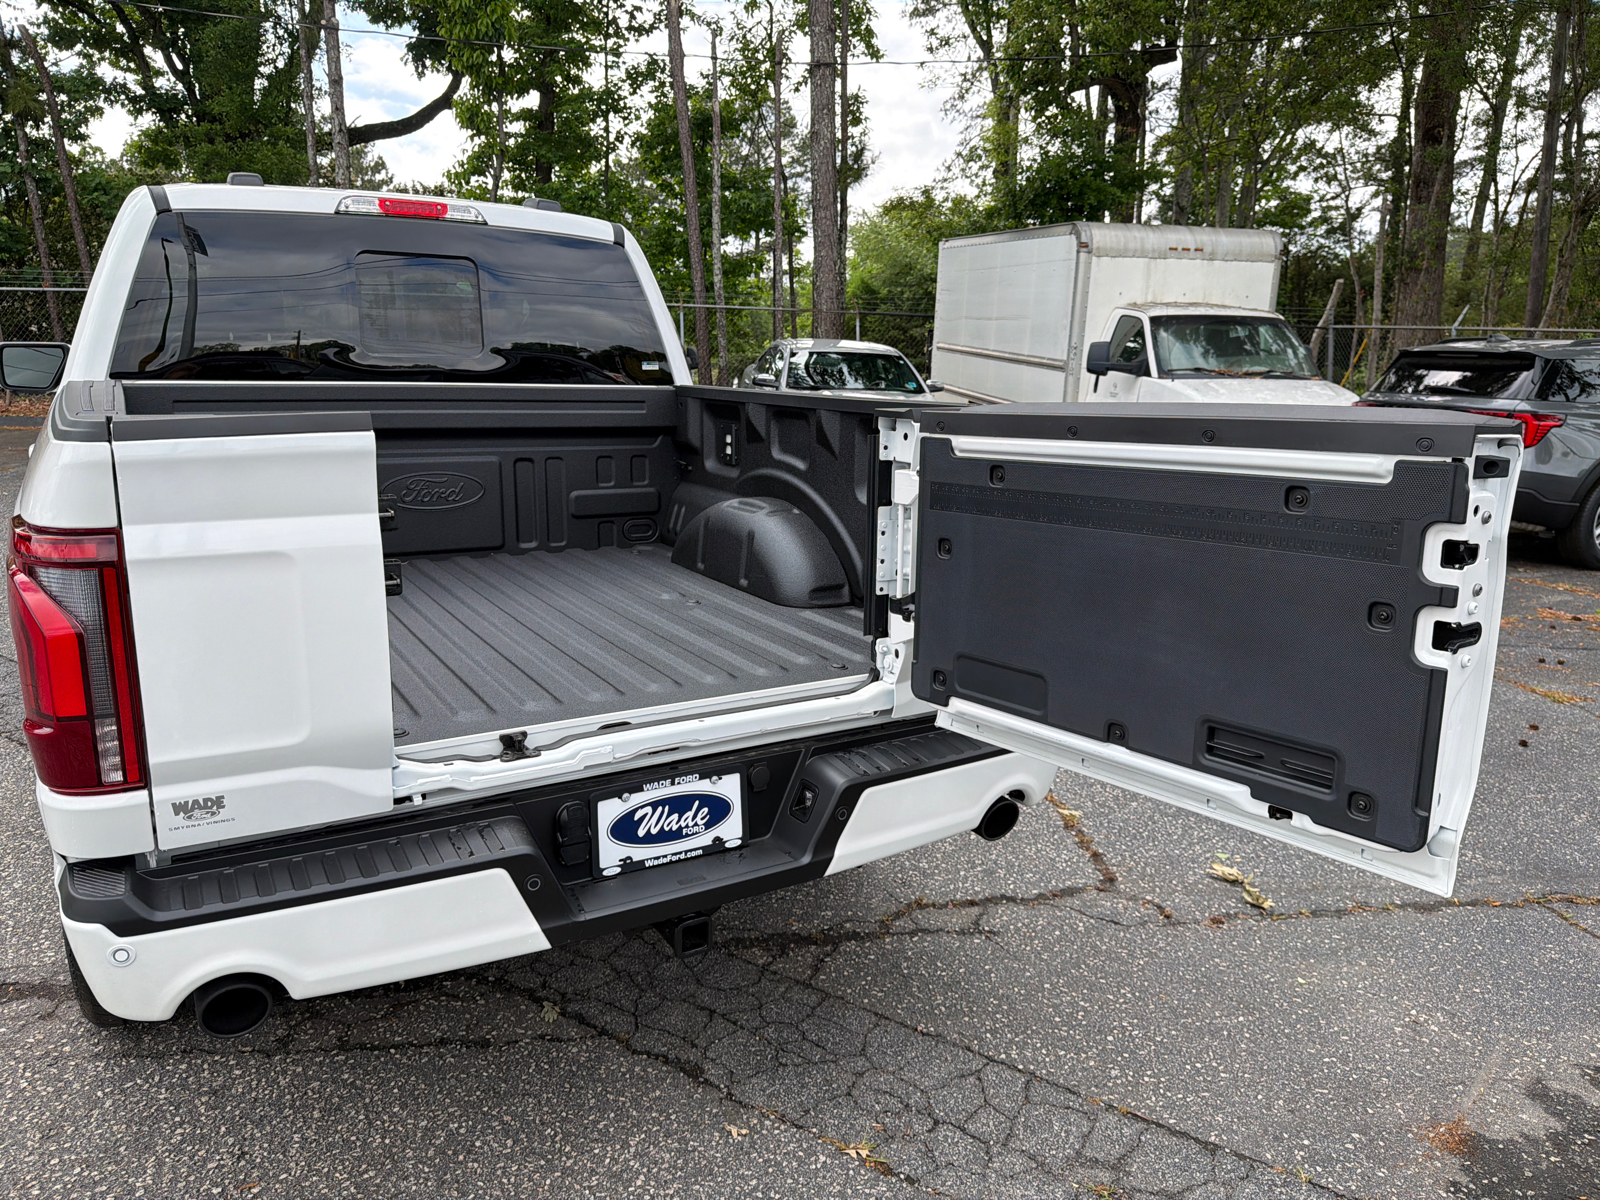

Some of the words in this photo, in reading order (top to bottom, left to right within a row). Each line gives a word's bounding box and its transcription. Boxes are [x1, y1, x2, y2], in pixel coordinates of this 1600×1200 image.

[400, 477, 465, 503] Ford
[643, 779, 671, 792] WADE
[675, 773, 700, 785] FORD
[171, 795, 226, 816] WADE
[633, 800, 710, 838] Wade
[683, 824, 706, 836] FORD
[644, 849, 703, 868] WadeFord.com
